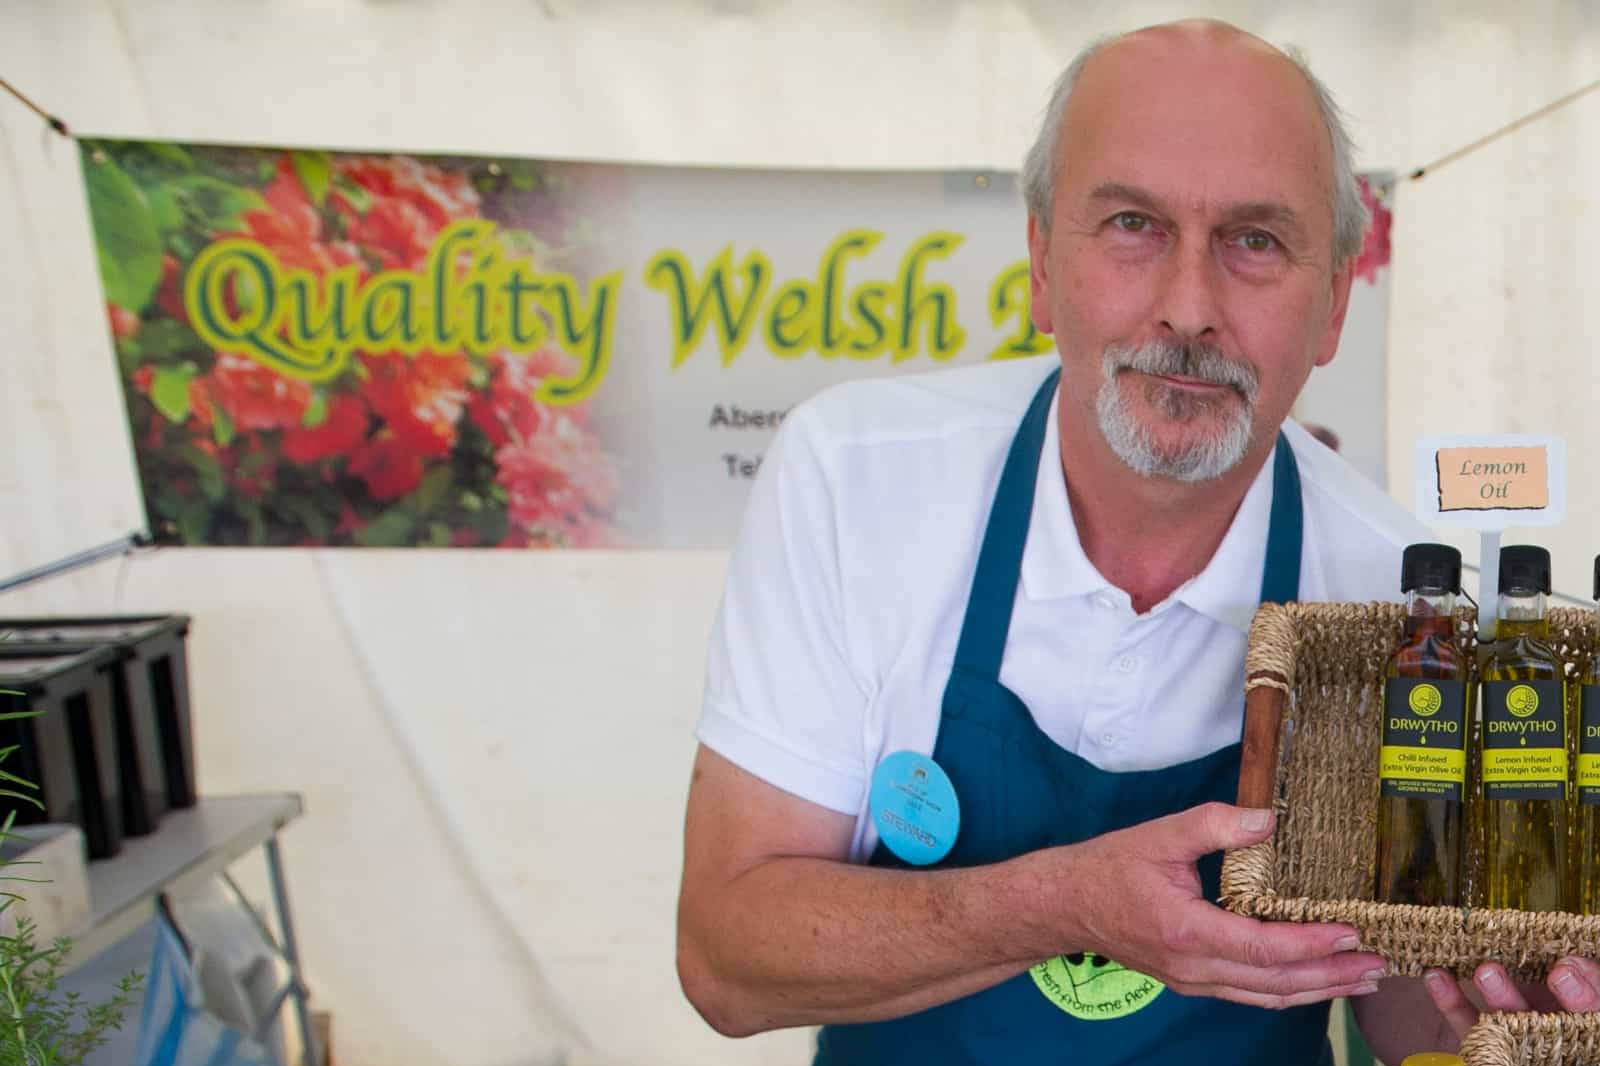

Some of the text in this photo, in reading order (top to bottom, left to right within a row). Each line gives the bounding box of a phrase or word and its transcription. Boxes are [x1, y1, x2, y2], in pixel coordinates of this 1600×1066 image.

[187, 217, 624, 406] Quality
[646, 231, 966, 369] Welsh
[1459, 459, 1527, 476] Lemon
[1480, 481, 1511, 499] Oil
[1398, 754, 1447, 763] Chilli Infused
[1495, 755, 1552, 764] Lemon Infused
